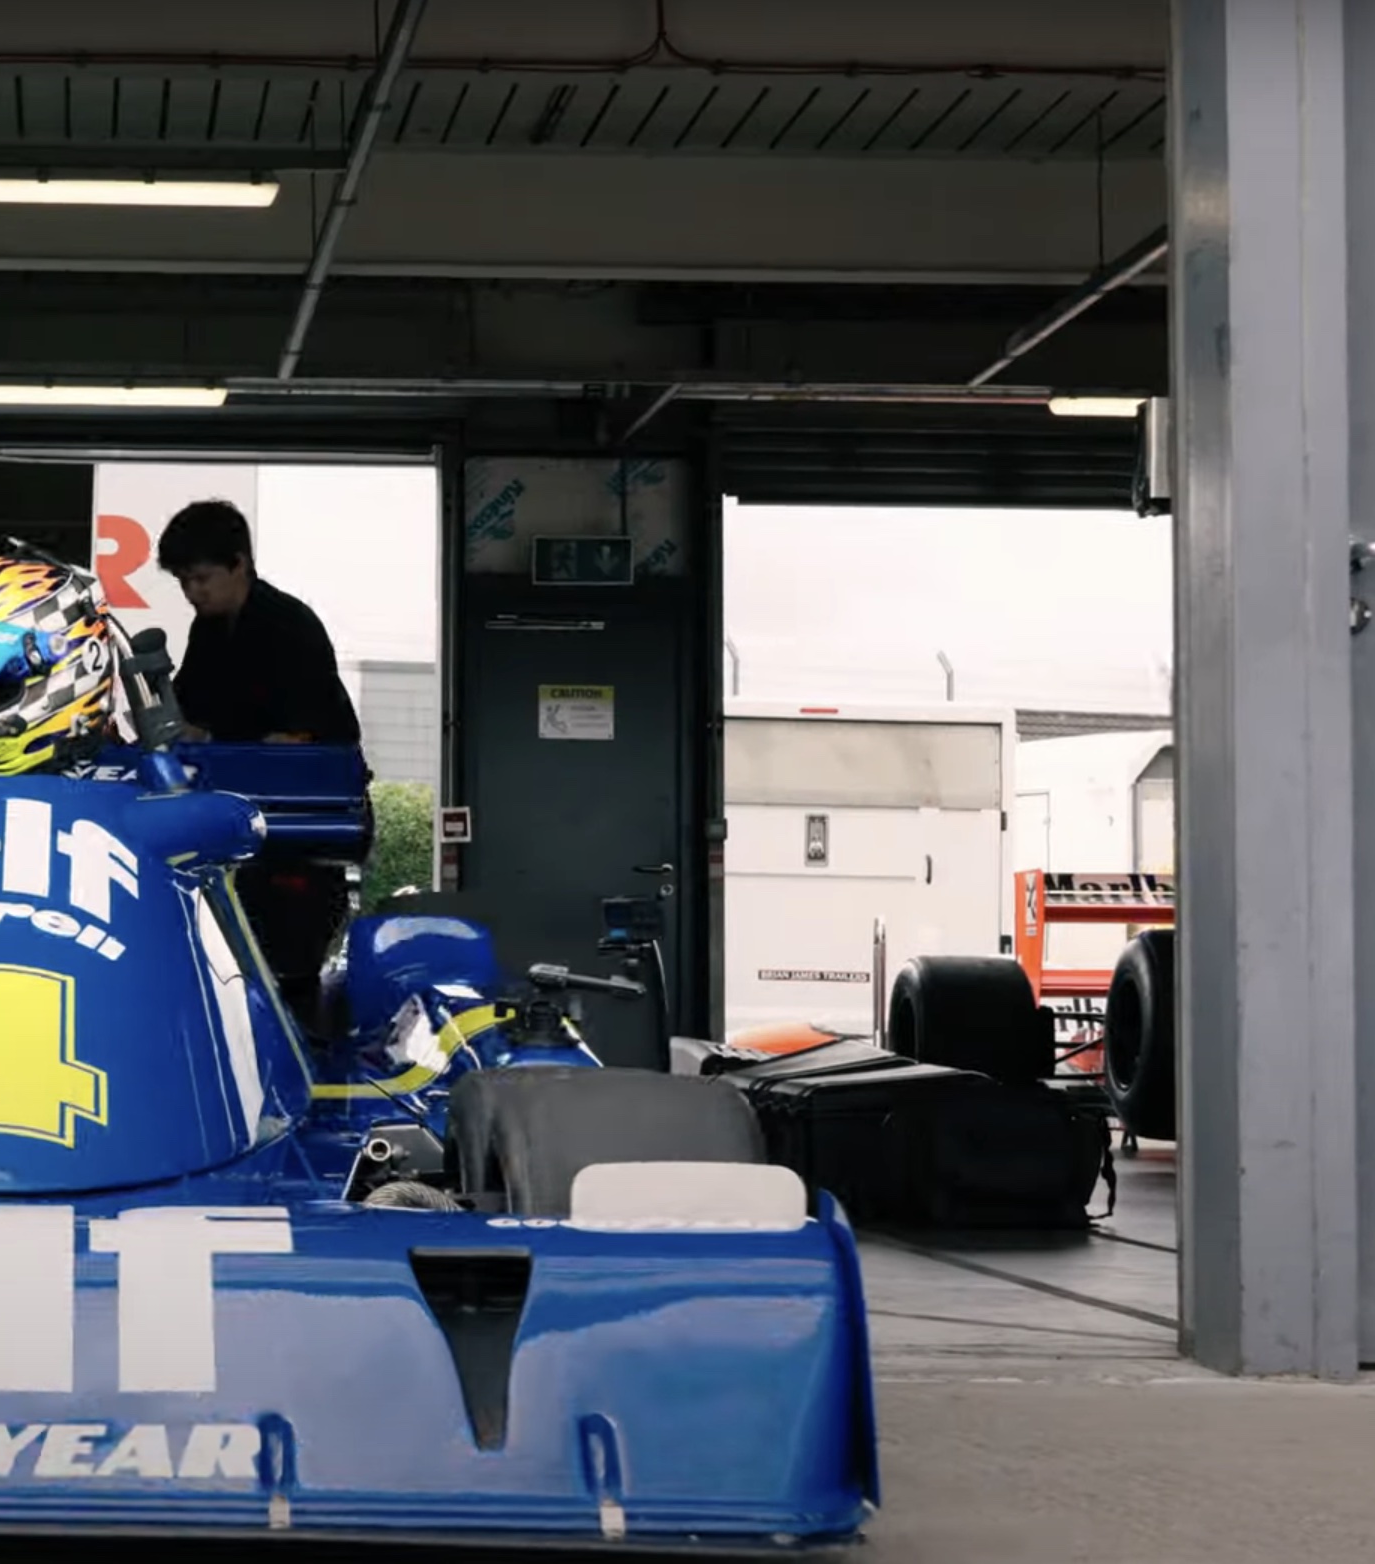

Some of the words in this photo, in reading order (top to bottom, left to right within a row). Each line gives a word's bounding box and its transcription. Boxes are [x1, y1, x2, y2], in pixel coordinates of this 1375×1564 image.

[89, 640, 103, 671] 2
[550, 688, 603, 699] CAUTION
[1045, 873, 1175, 903] Marlb
[760, 970, 790, 980] BRIAN
[791, 971, 821, 981] JAMES
[823, 972, 867, 983] TRAILERS
